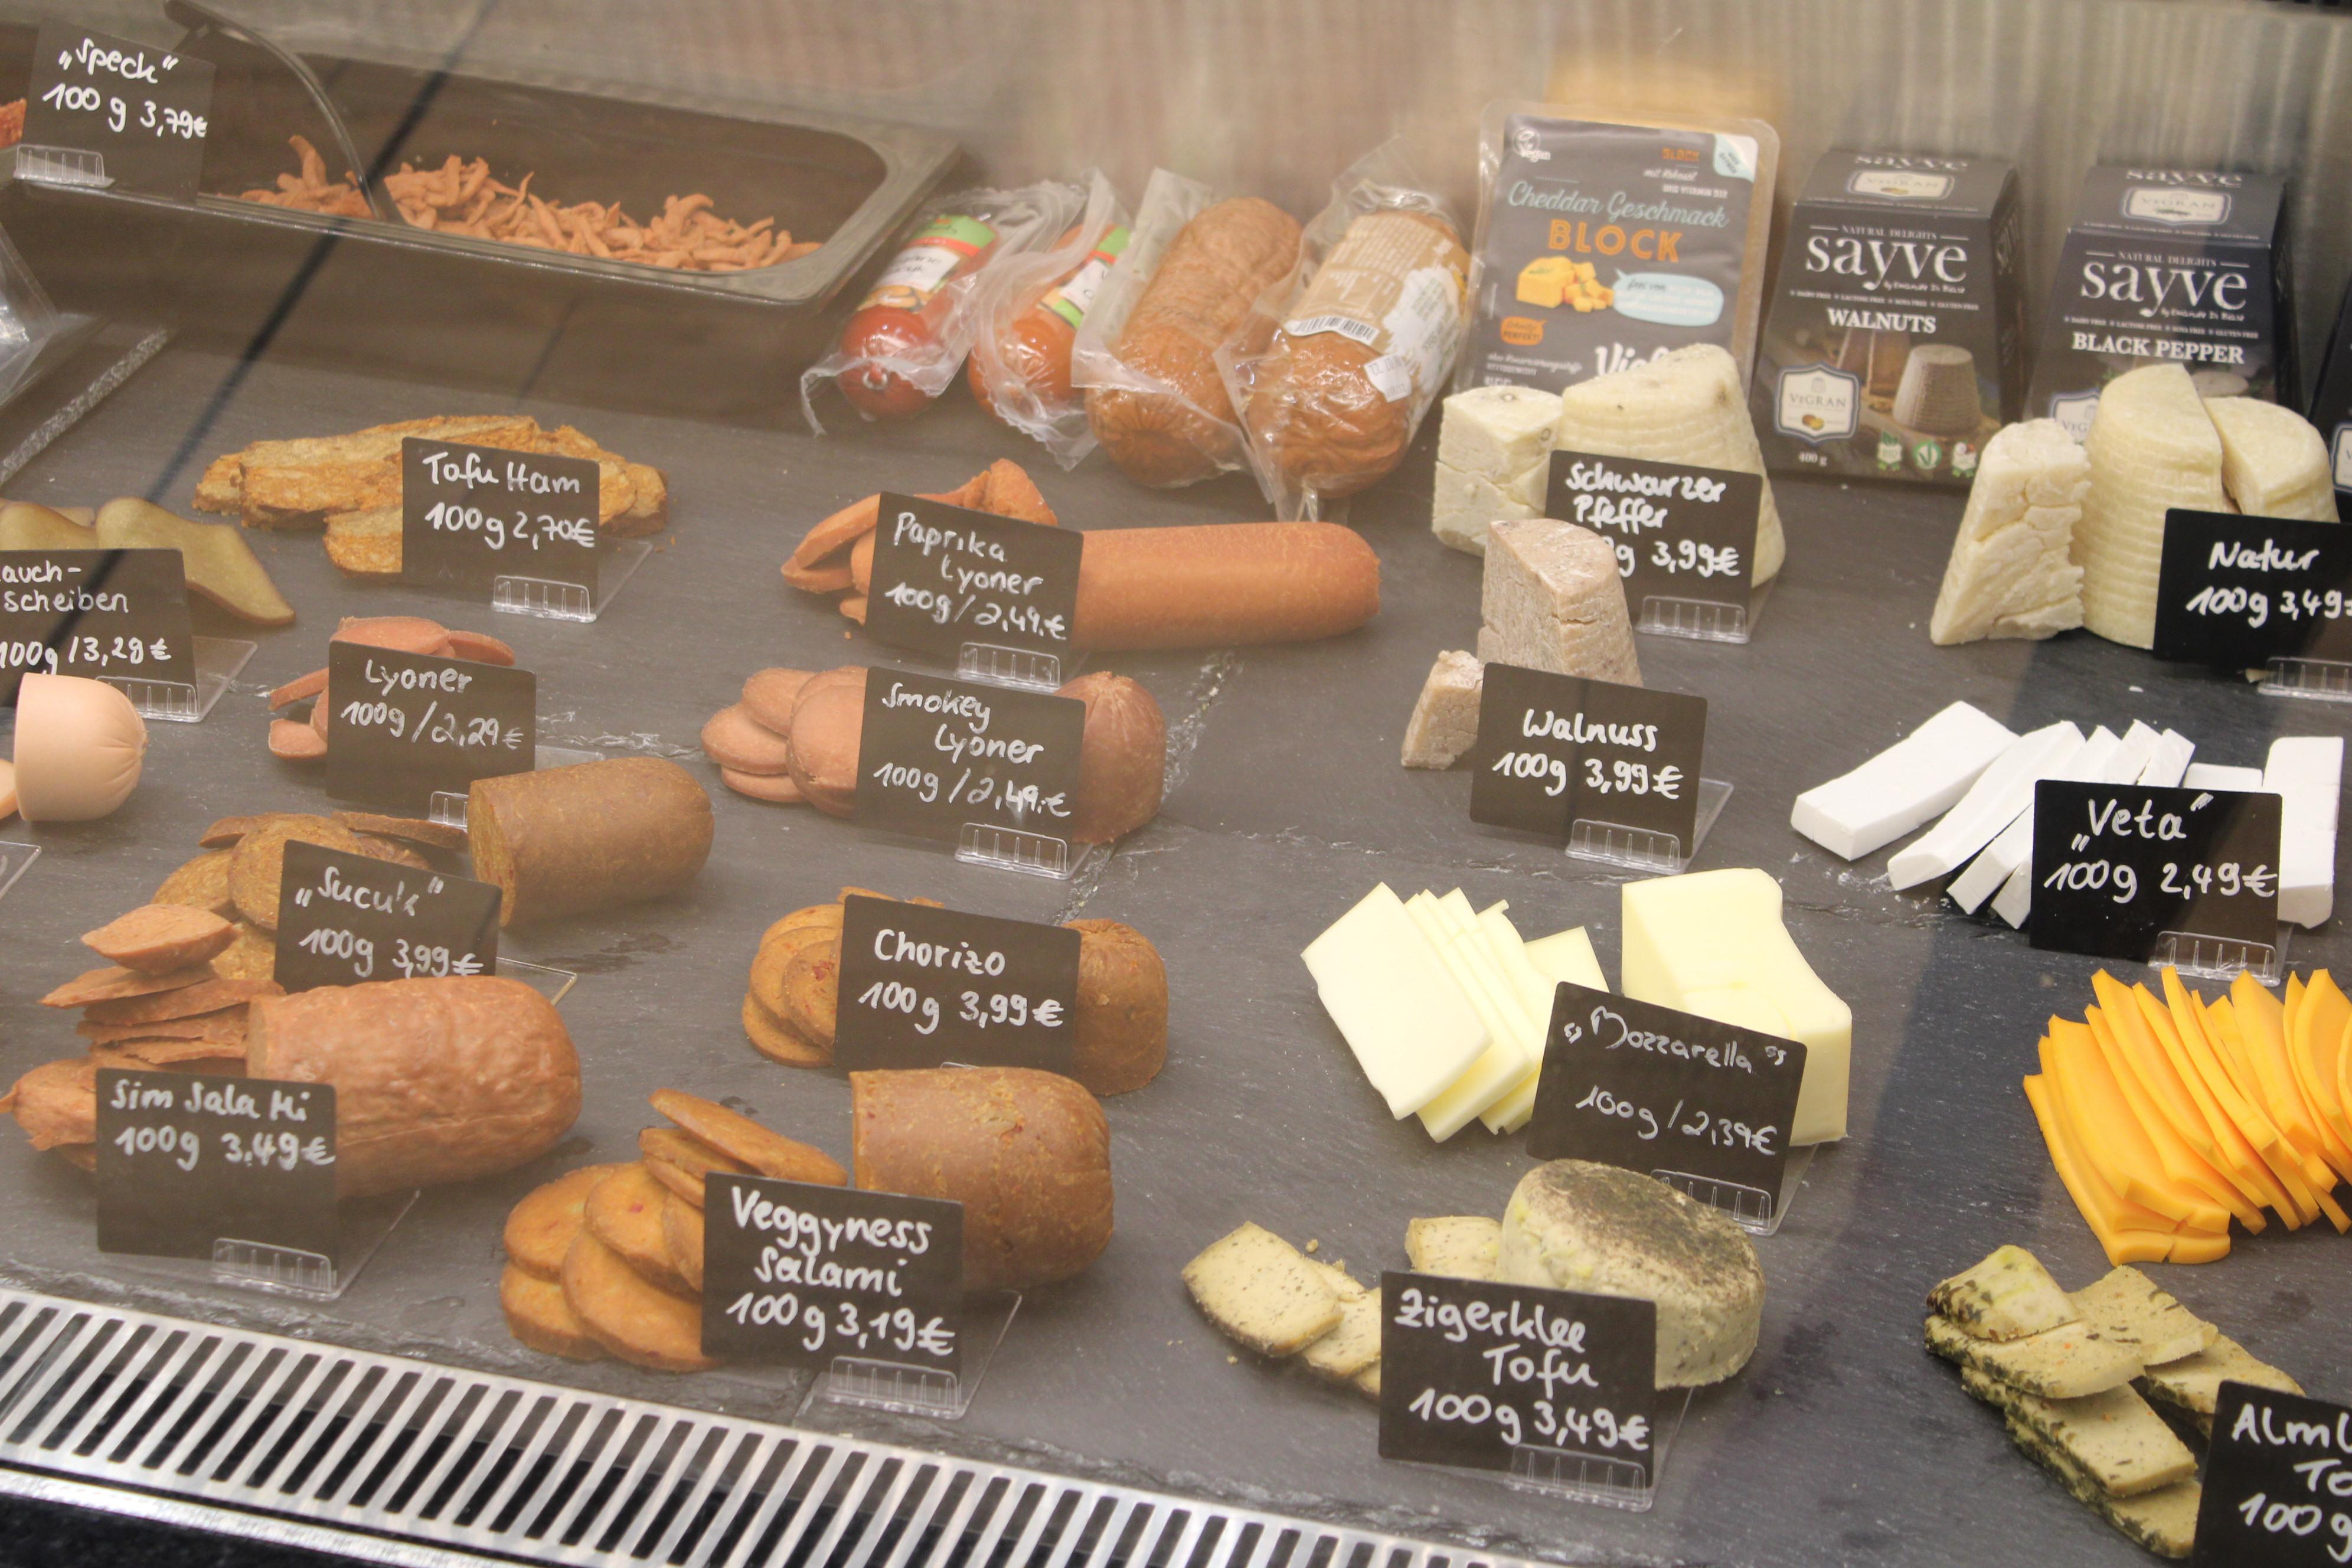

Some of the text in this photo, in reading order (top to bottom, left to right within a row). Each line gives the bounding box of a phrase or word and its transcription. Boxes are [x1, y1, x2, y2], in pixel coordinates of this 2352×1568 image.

[139, 100, 207, 138] 3,79€
[1508, 180, 1730, 228] Cheddar Geschmack
[1548, 218, 1684, 263] BLOCK
[1841, 225, 1938, 240] NATURAL DELIGHTS
[1805, 236, 1968, 291] sayve
[2118, 250, 2217, 267] NATURAL DELIGHTS
[2081, 262, 2248, 318] sayve
[1827, 308, 1936, 334] WALNUTS
[2072, 331, 2245, 365] BLACK PEPPER
[423, 452, 580, 494] Tofu Ham
[1565, 459, 1727, 504] Schwarzer
[424, 502, 595, 550] 100g 2,70€
[893, 511, 1007, 562] Paprika
[1573, 494, 1668, 535] Pfeffer
[0, 560, 81, 583] auch-
[940, 553, 1044, 596] Lyoner
[1651, 538, 1741, 578] 3,99€
[2209, 538, 2321, 573] Natur
[2186, 586, 2268, 629] 100g
[365, 659, 473, 697] Lyoner
[881, 682, 991, 734] Smokey
[1523, 708, 1658, 752] Walnuss
[935, 723, 1044, 764] Lyoner
[1492, 752, 1684, 800] 100g 3,99€
[2043, 859, 2278, 904] 100g 2,49€
[298, 927, 484, 979] 100g 3,99€
[874, 929, 1006, 976] Chorizo
[959, 991, 1064, 1029] 3,99€
[110, 1079, 174, 1110] Sim
[184, 1081, 261, 1119] Sala
[114, 1125, 337, 1172] 100g 3,49€
[731, 1185, 933, 1257] Veggyness
[754, 1246, 909, 1298] Salami
[836, 1302, 956, 1356] 3,19€
[1482, 1343, 1599, 1400] Tofu
[1534, 1400, 1651, 1451] 3,49€
